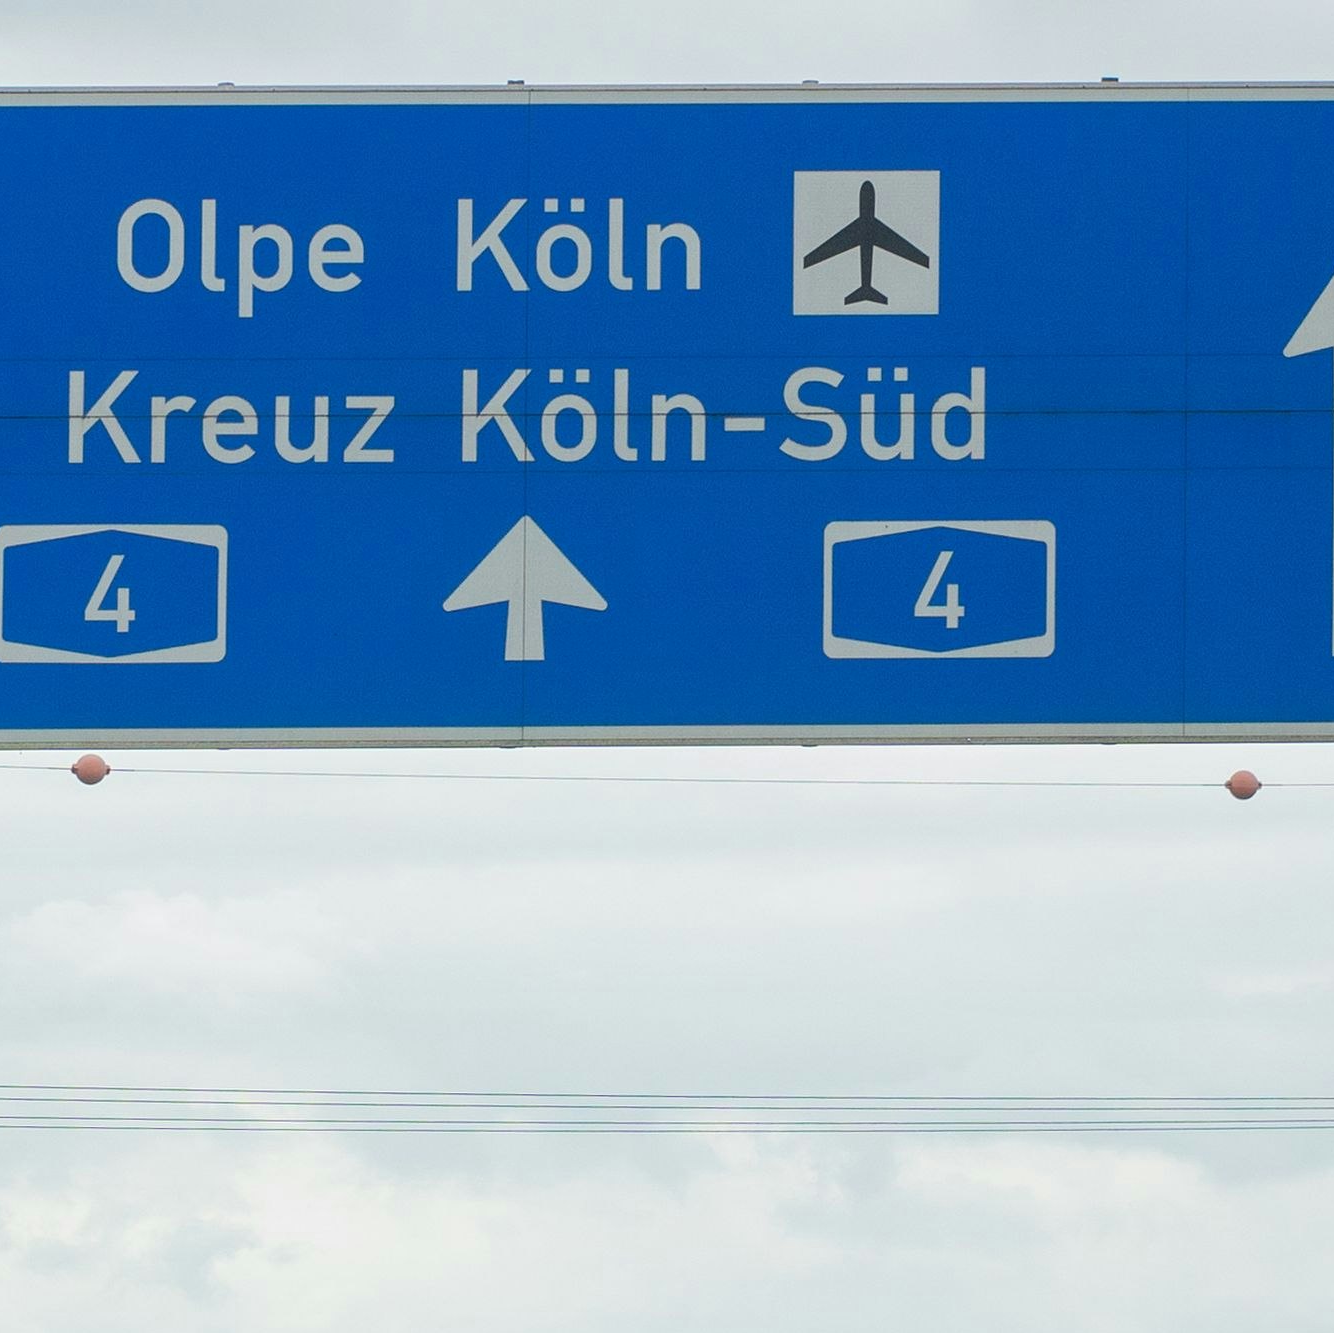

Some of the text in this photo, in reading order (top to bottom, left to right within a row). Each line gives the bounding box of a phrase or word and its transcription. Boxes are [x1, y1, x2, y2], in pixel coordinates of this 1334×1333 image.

[117, 198, 701, 318] Olpe Köln
[68, 366, 986, 464] Kreuz Köln-Süd
[84, 554, 136, 633] 4
[914, 551, 965, 629] 4
